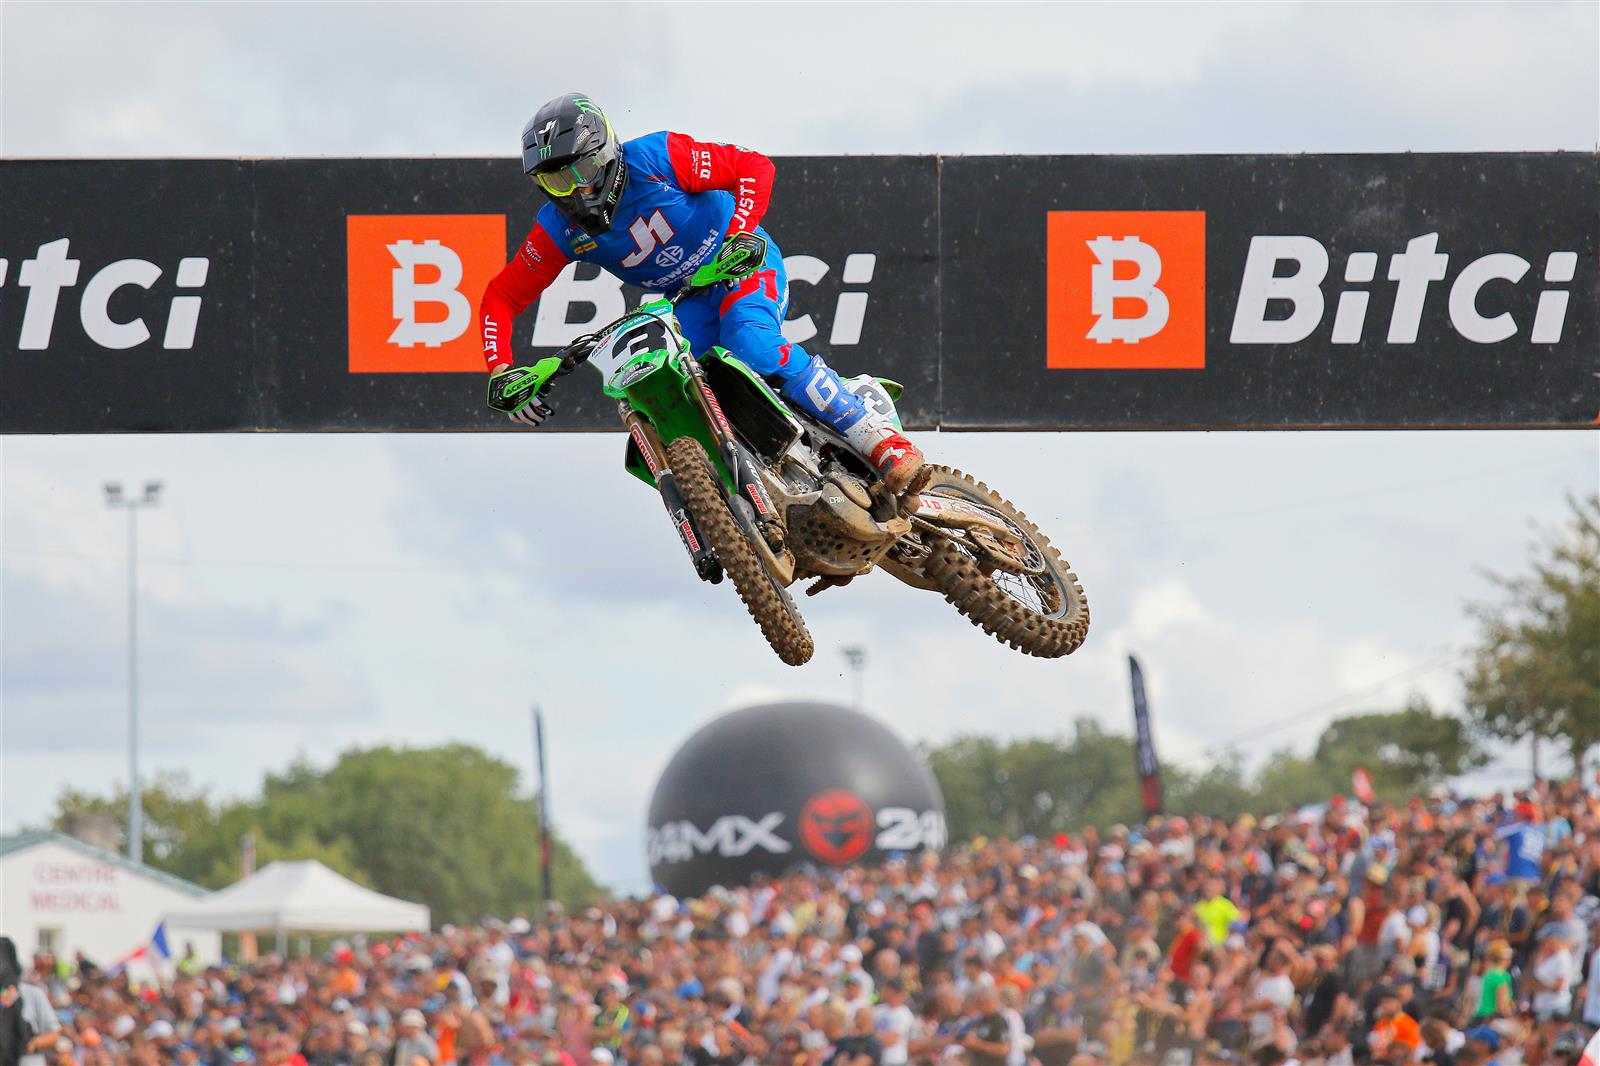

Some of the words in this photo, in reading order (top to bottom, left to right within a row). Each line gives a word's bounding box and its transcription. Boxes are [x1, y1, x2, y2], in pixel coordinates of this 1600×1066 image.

[0, 238, 209, 350] tci
[641, 228, 719, 288] Kawasaki
[1229, 232, 1578, 344] Bitci
[531, 253, 877, 348] Bci
[611, 319, 668, 360] 3
[681, 520, 700, 552] BRAKING
